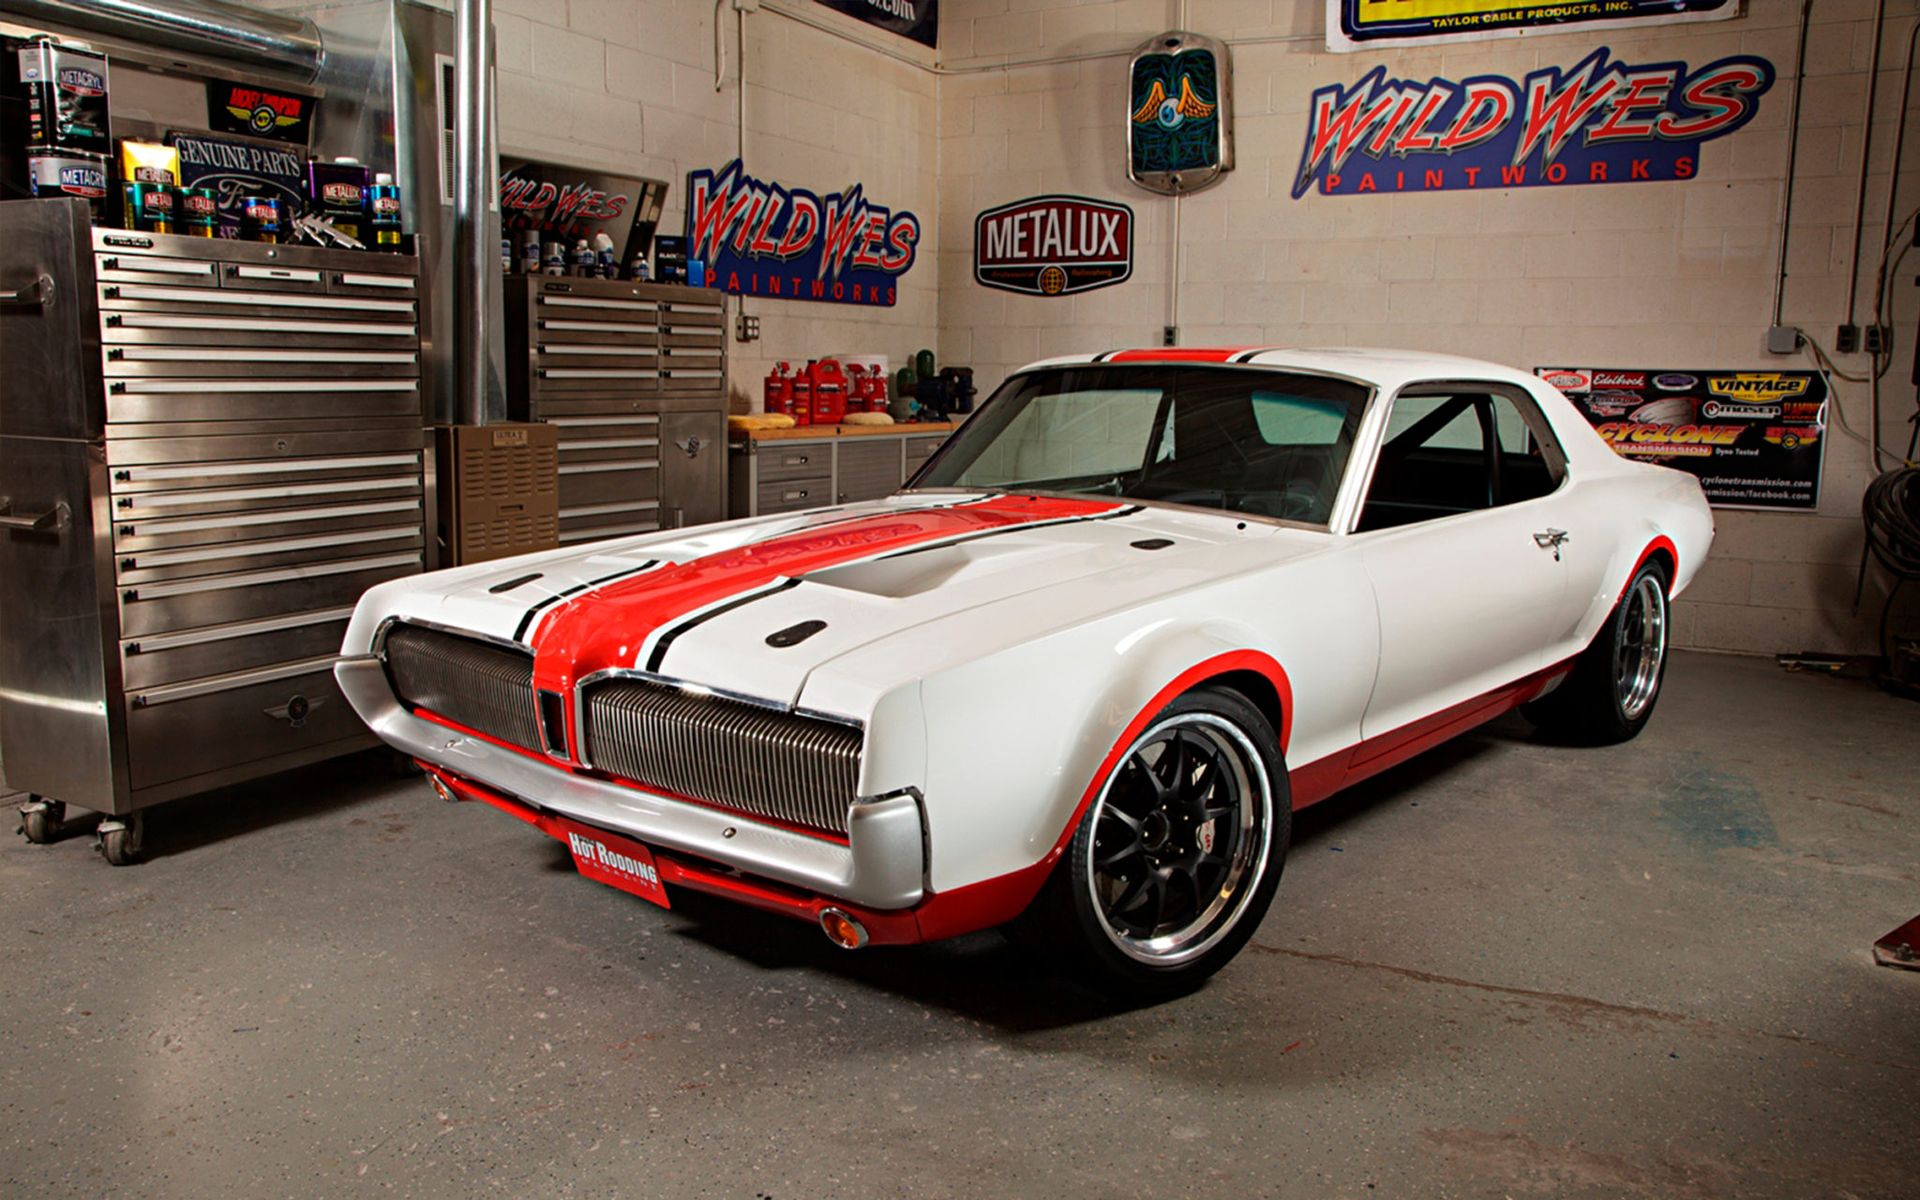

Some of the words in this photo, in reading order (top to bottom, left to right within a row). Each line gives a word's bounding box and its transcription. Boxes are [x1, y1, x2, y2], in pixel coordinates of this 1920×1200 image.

[1432, 15, 1479, 28] TAYLOR
[1481, 11, 1523, 23] CABLE
[1527, 4, 1601, 19] PRODUCTS,
[1605, 2, 1633, 11] INC.
[1302, 70, 1515, 182] WILD
[1512, 58, 1762, 180] WES
[176, 138, 250, 170] GENUINE
[250, 148, 300, 177] PARTS
[1326, 156, 1694, 193] PAINTWORKS
[551, 182, 628, 222] WES
[693, 168, 819, 268] WILD
[816, 193, 916, 280] WES
[987, 207, 1120, 259] METALUX
[705, 268, 895, 304] PAINTWORKS
[1593, 373, 1645, 386] Edelbrock
[1598, 423, 1748, 444] CYCLONE
[1614, 444, 1708, 455] TRANSMISSION
[1715, 448, 1733, 456] Dyno
[1736, 448, 1759, 456] Tested
[596, 841, 658, 884] RODDING
